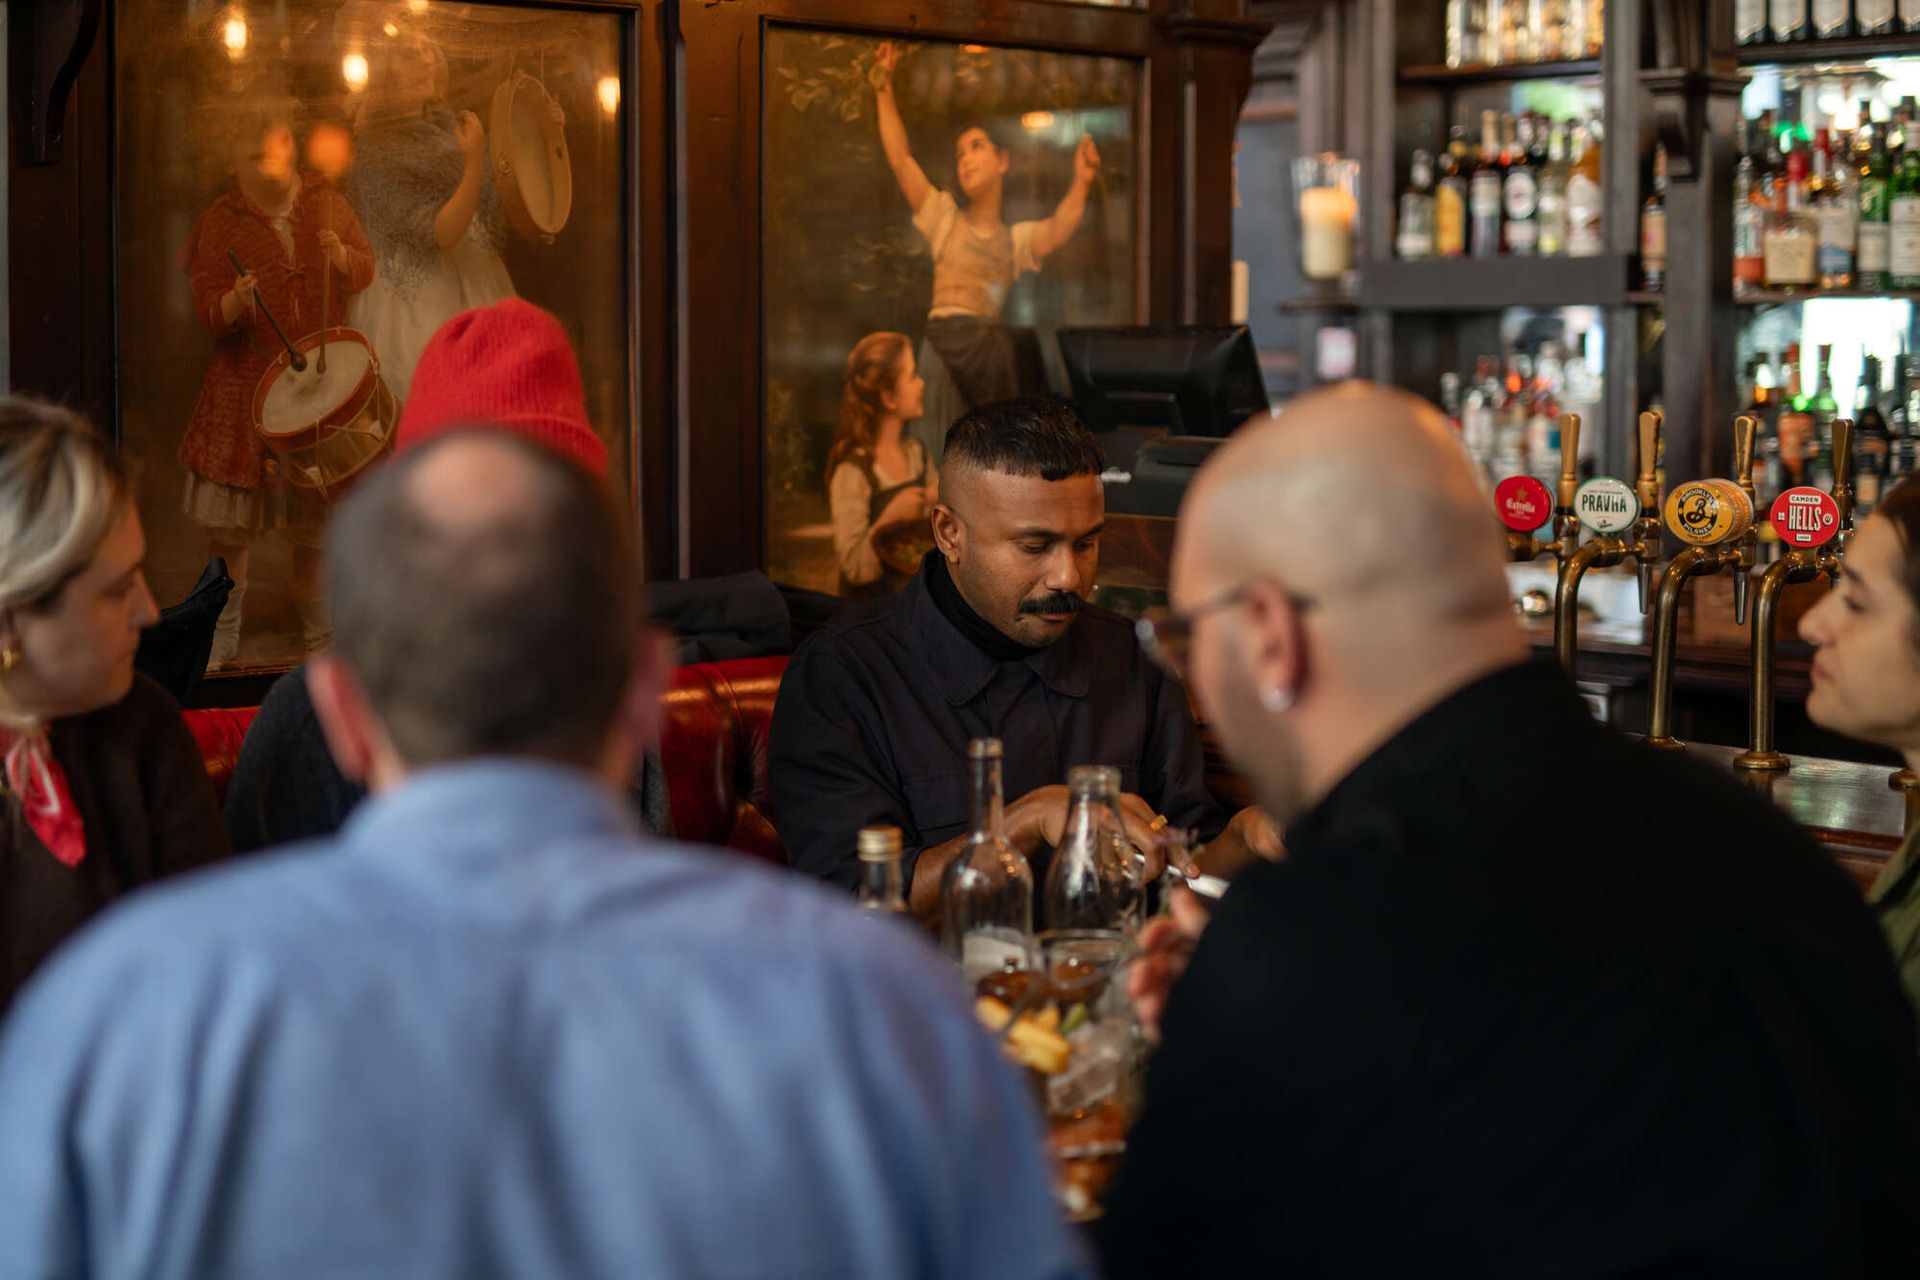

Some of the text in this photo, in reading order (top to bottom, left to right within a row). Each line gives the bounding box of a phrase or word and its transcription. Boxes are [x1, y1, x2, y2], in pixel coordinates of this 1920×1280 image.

[1582, 494, 1627, 512] PRAVHA
[1681, 488, 1715, 504] BROOKLYN
[1791, 495, 1819, 503] CAMDEN
[1788, 505, 1822, 532] HELLS
[1683, 522, 1713, 535] PILSNER
